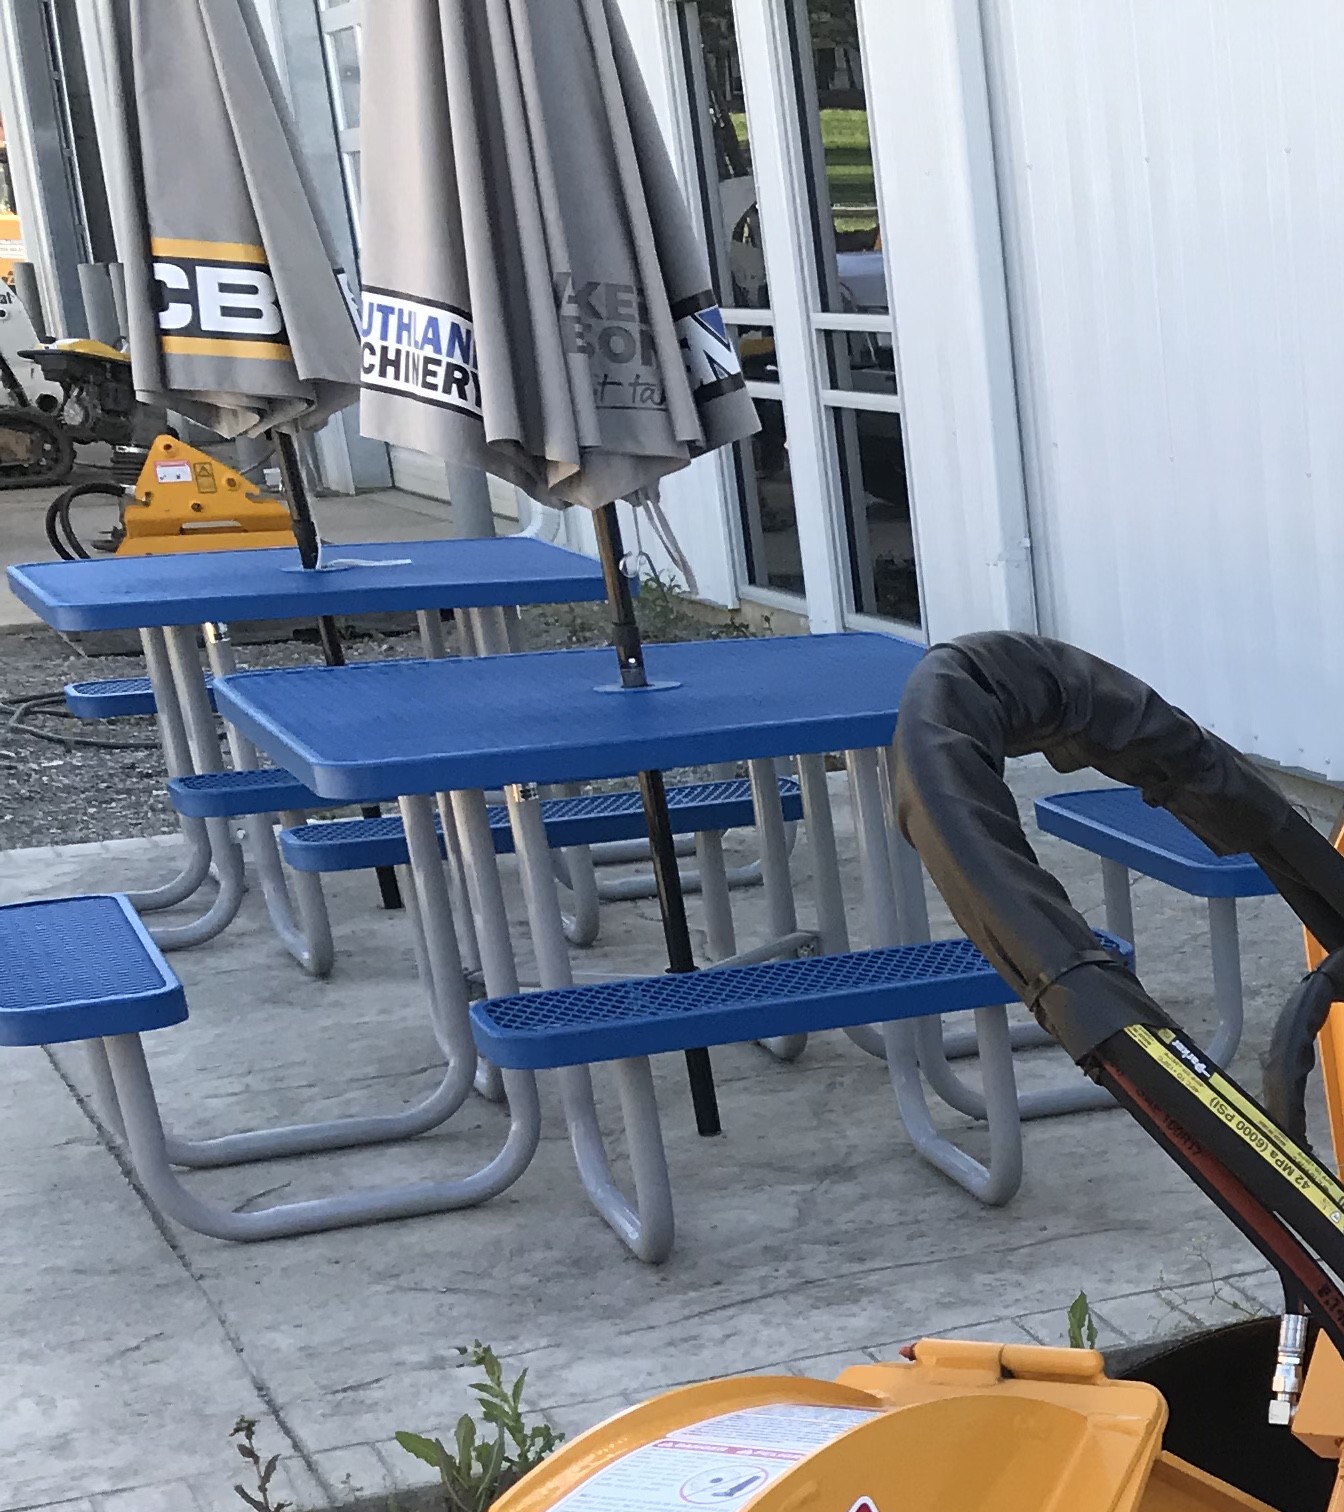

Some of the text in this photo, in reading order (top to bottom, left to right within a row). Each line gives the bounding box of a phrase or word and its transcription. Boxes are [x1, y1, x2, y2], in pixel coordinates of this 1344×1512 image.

[361, 302, 478, 370] UTHLAN
[1168, 1037, 1215, 1079] Parker
[1206, 1094, 1238, 1124] PSI)
[1231, 1118, 1271, 1155] (6000
[1265, 1148, 1298, 1178] MPa
[1293, 1172, 1314, 1192] 42
